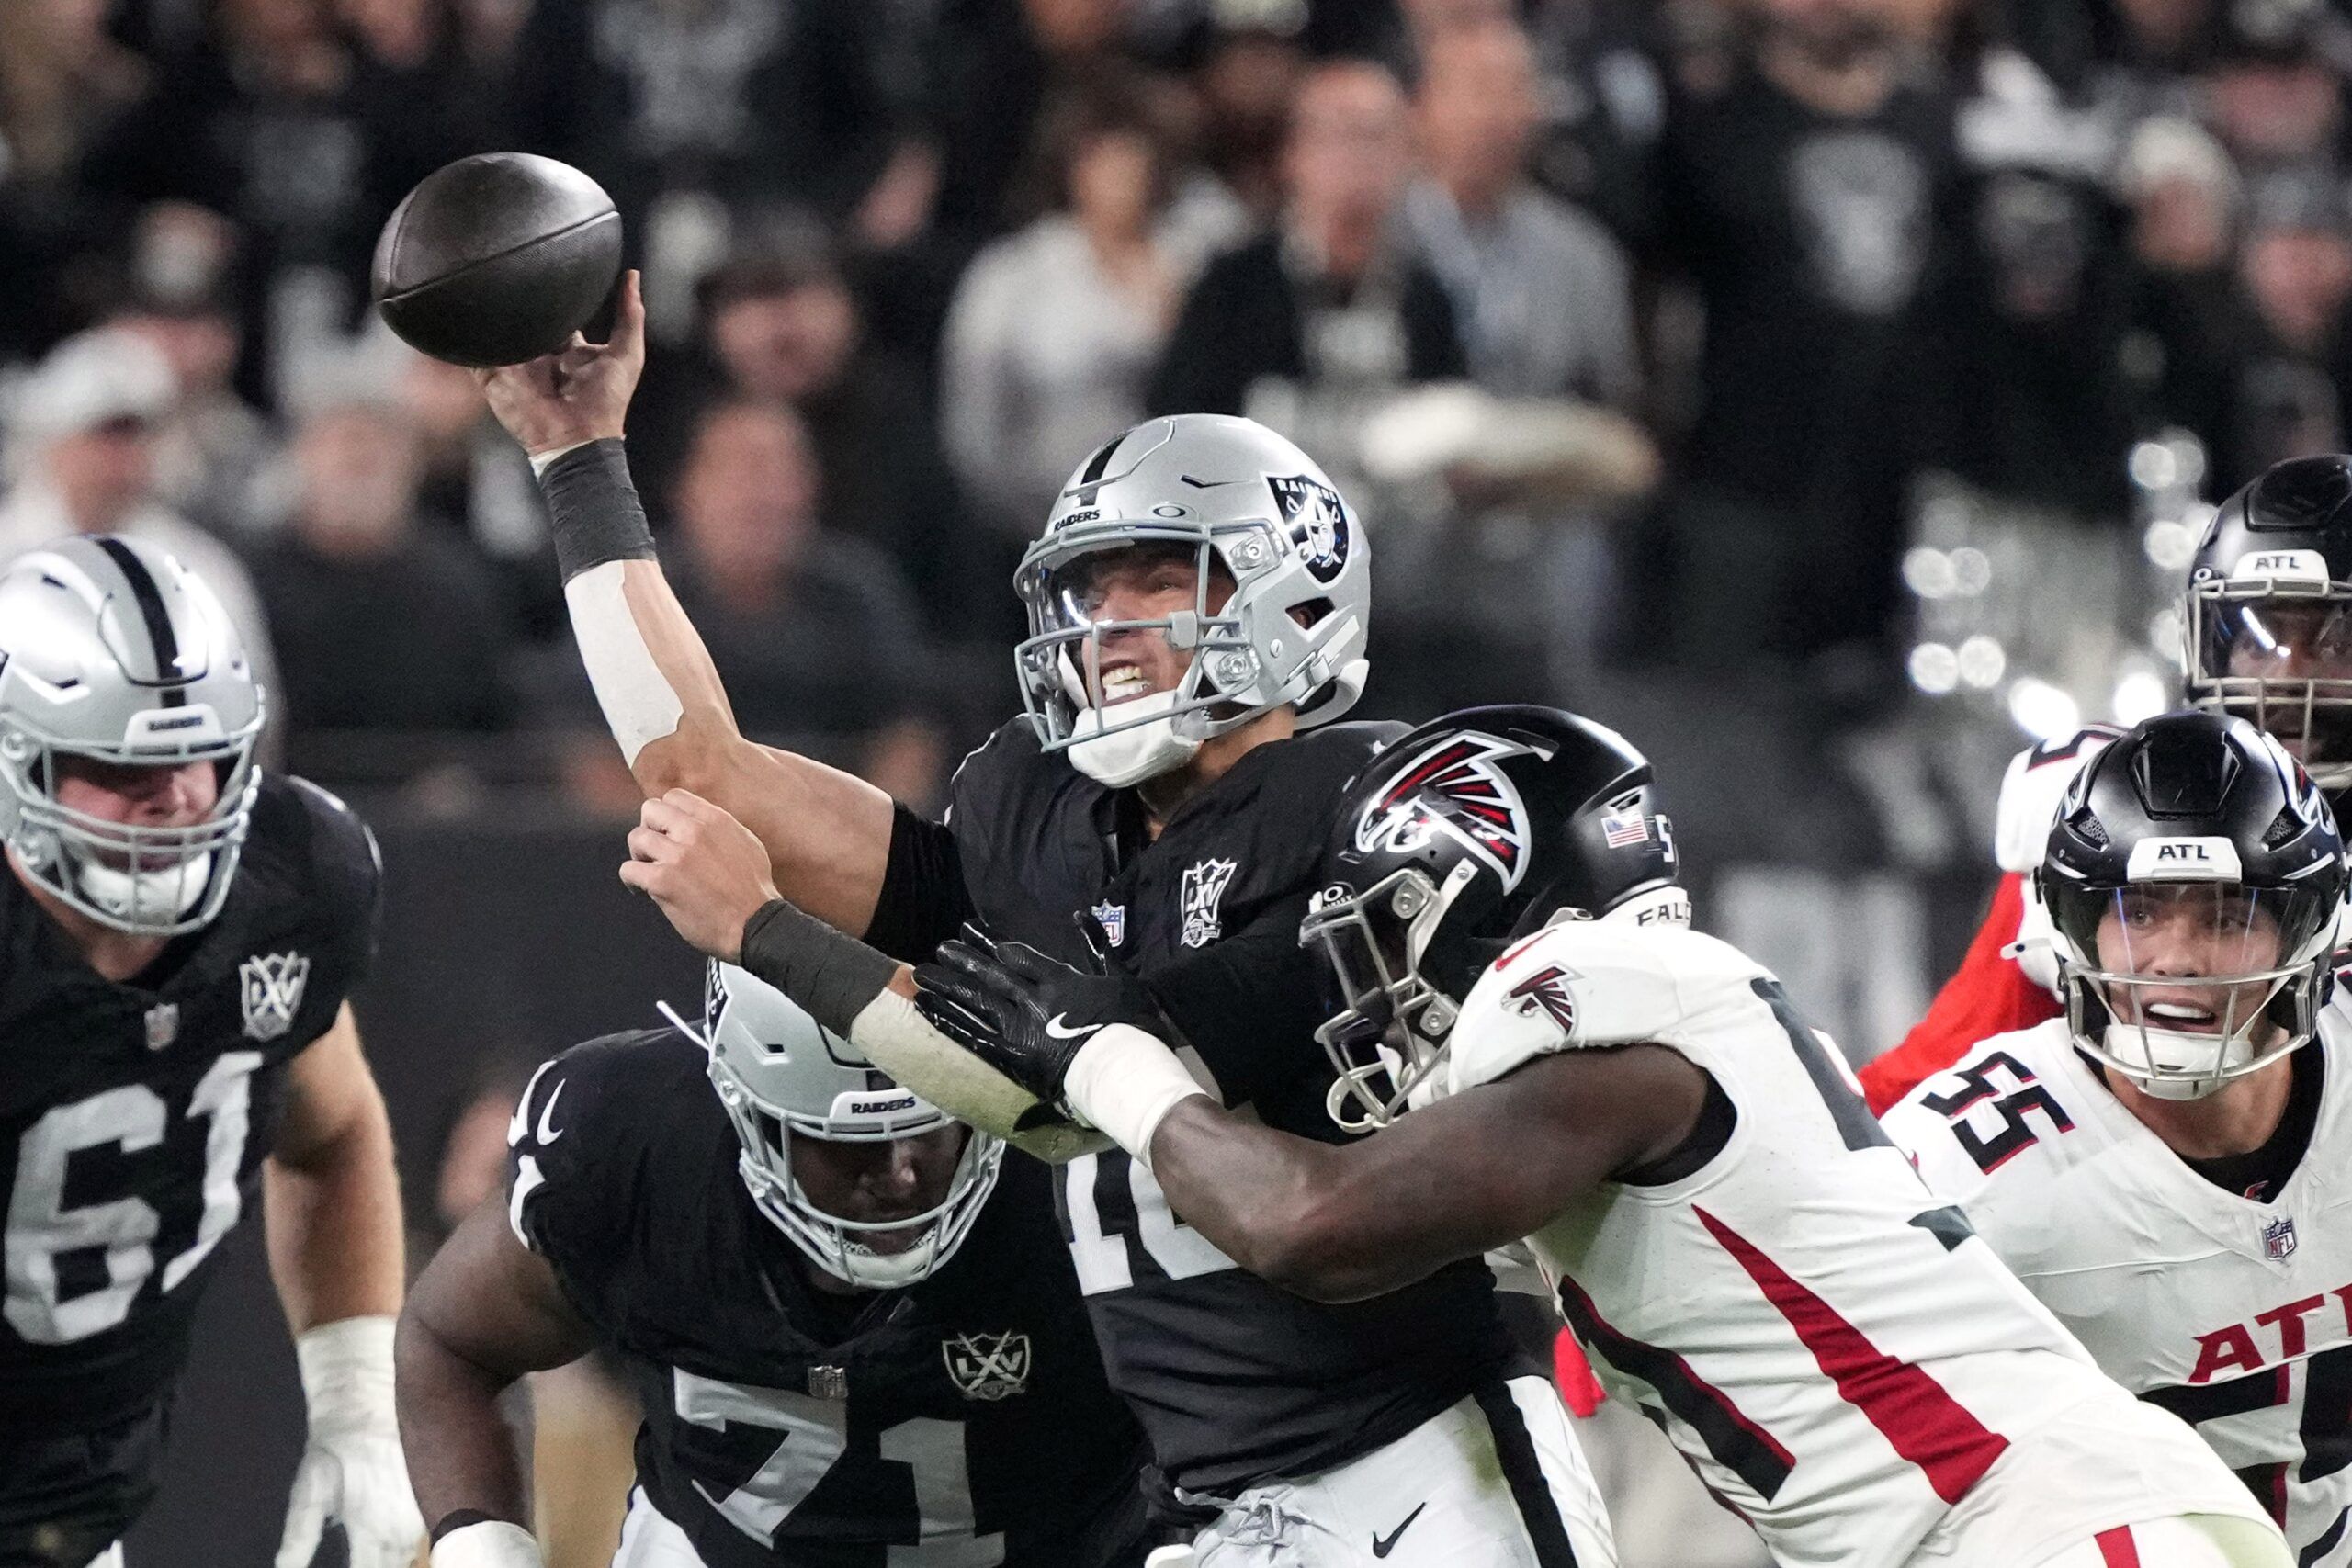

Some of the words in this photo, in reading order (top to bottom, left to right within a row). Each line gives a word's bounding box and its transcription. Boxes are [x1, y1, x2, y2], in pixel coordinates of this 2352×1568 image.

[1054, 508, 1101, 533] RAIDERS
[2255, 555, 2300, 570] ATL
[2157, 844, 2210, 860] ATL
[851, 1096, 916, 1114] RAIDERS
[1919, 1051, 2076, 1176] 55
[3, 1050, 264, 1346] 61
[2268, 1235, 2293, 1258] NFL
[673, 1365, 1005, 1568] 71
